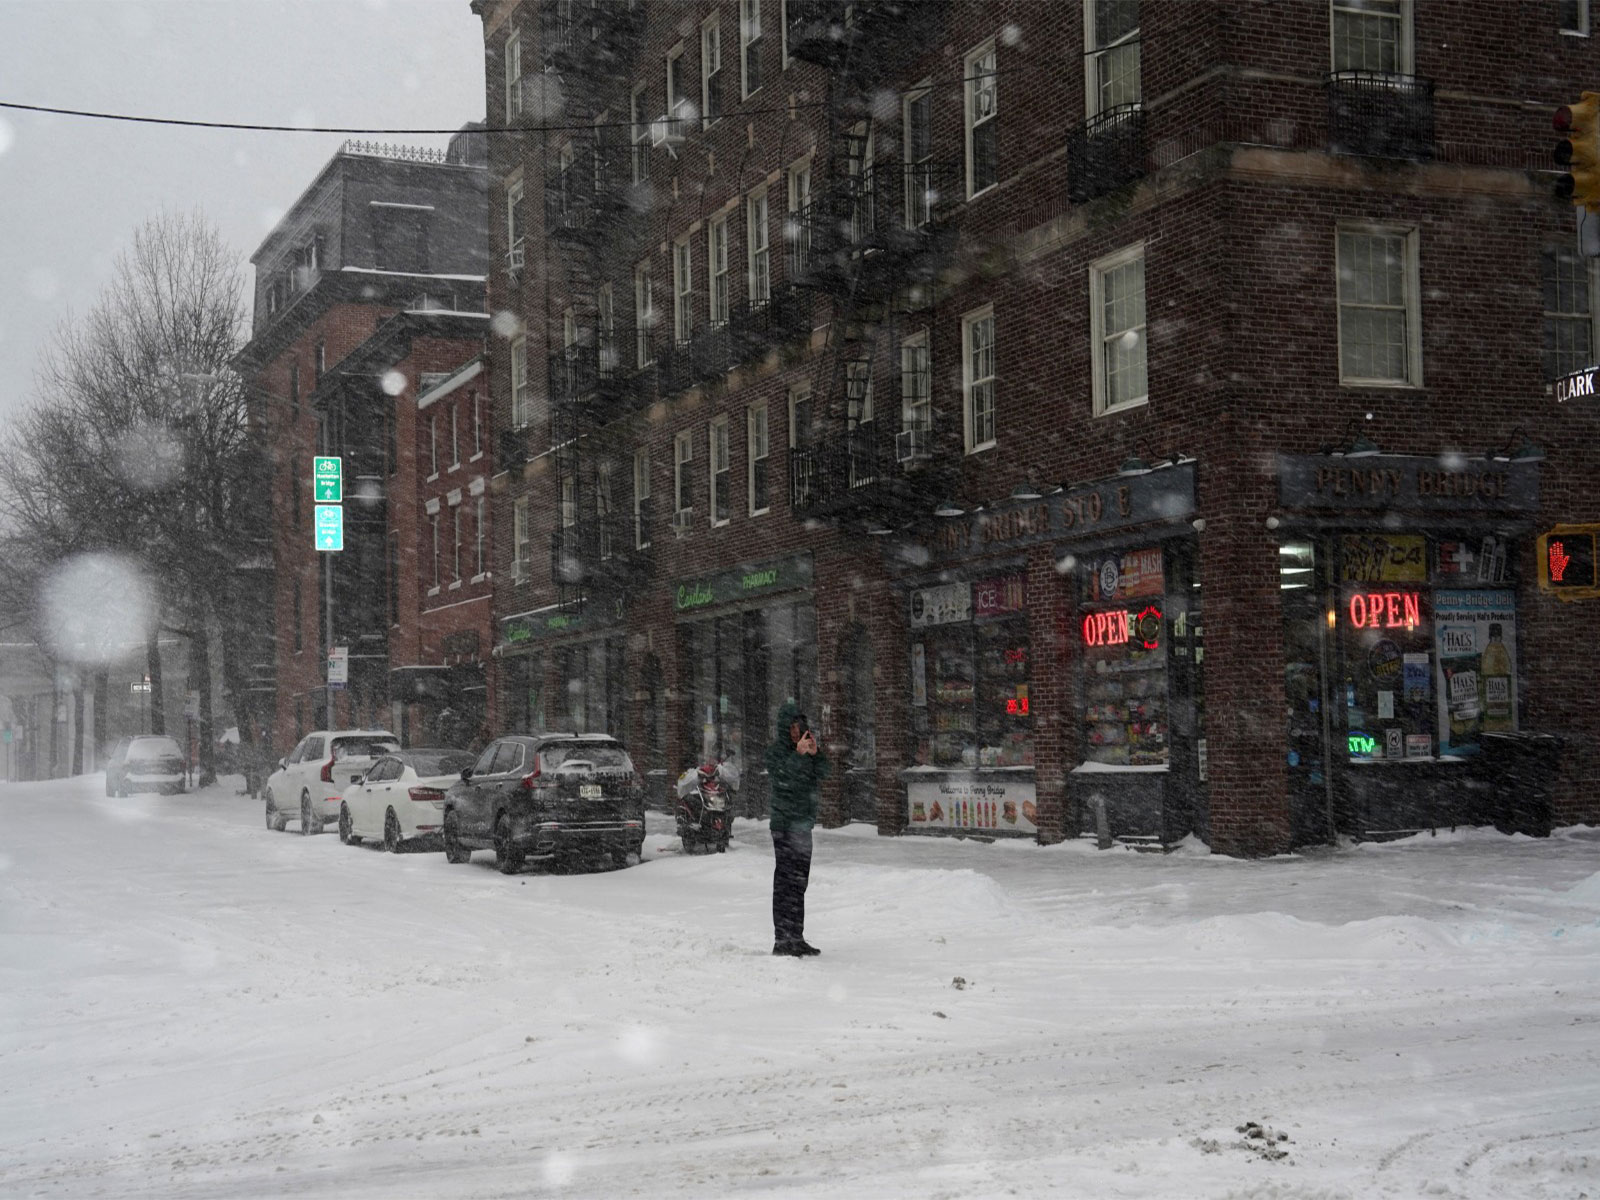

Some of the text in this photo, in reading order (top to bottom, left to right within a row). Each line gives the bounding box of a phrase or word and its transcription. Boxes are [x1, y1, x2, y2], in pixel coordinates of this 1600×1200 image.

[1557, 373, 1595, 403] CLARK
[1315, 467, 1509, 496] PENNY BRIDGE
[743, 569, 777, 590] PHARMACY
[978, 590, 996, 609] ICE
[1435, 593, 1511, 608] Penny Bridge Deli
[1350, 592, 1420, 628] OPEN
[1435, 611, 1514, 622] Proudly Serving Hal's Products
[1084, 610, 1129, 647] OPEN
[1447, 632, 1472, 647] HAL'S
[939, 784, 1006, 797] Welcome to Penny Bridge
